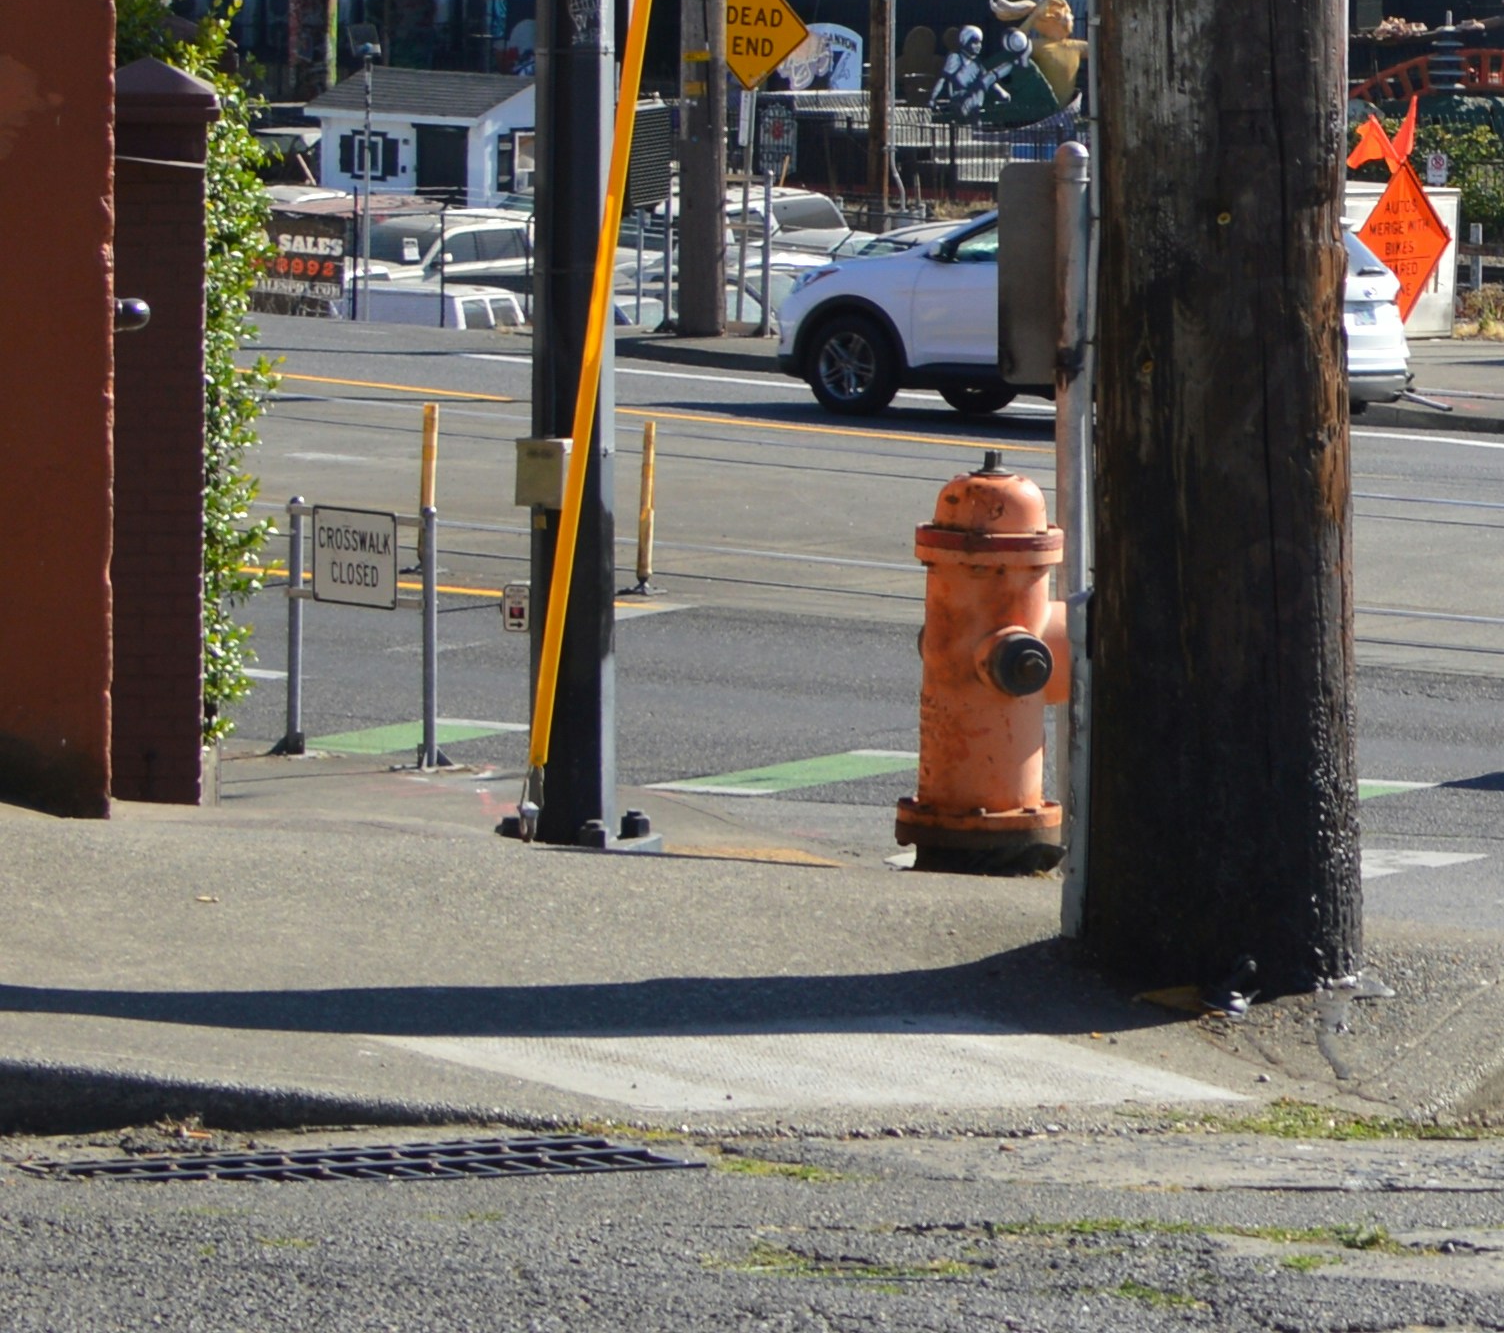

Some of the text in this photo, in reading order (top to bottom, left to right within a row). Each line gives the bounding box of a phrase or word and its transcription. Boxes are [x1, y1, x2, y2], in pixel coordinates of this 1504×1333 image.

[727, 6, 783, 28] DEAD
[732, 36, 774, 57] END
[278, 233, 343, 256] SALES
[318, 526, 391, 555] CROSSWALK
[331, 561, 379, 587] CLOSED
